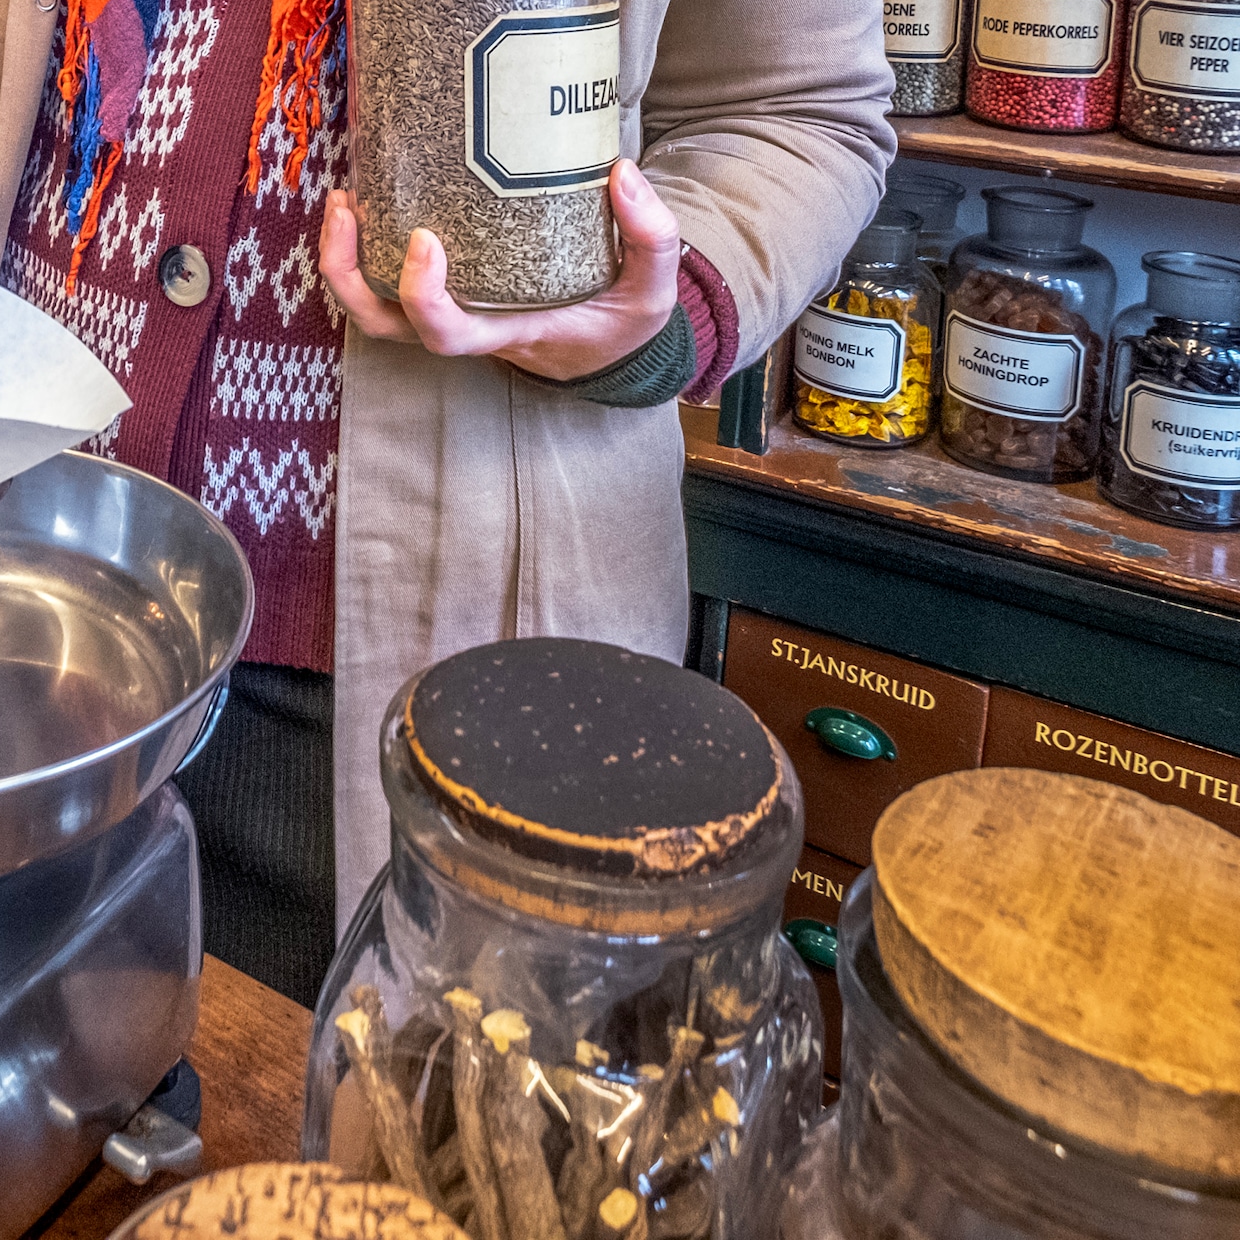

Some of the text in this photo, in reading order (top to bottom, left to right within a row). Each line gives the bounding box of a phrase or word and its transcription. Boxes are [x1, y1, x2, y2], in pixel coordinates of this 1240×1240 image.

[983, 17, 1099, 39] RODE PEPERKORRELS
[1159, 30, 1240, 52] VIER SEIZOE
[1190, 58, 1229, 74] PEPER
[798, 325, 875, 358] HONING MELK
[806, 345, 855, 370] BONBON
[973, 346, 1030, 371] ZACHTE
[957, 356, 1050, 388] HONINGDROP
[771, 637, 936, 711] ST.JANSKRUID
[1035, 721, 1240, 808] ROZENBOTTEL
[791, 867, 843, 903] MEN
